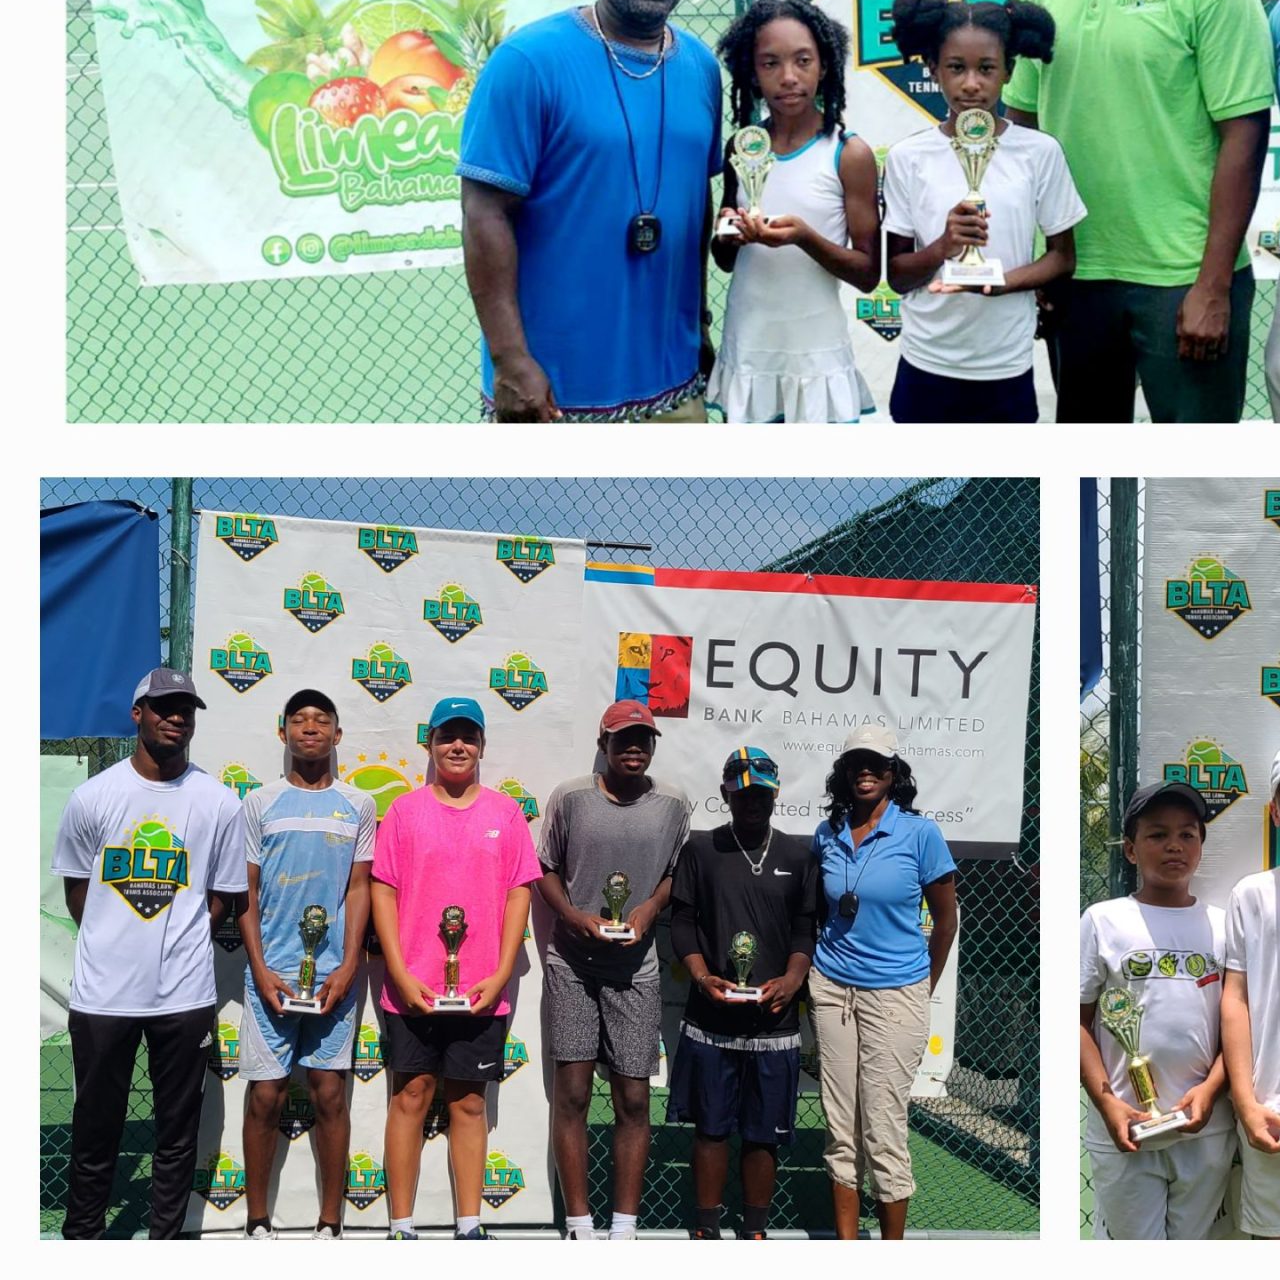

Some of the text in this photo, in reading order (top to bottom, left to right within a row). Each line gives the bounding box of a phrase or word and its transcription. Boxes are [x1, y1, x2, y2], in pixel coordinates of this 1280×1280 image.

[342, 171, 460, 207] Bahama
[216, 516, 279, 542] BLTA
[358, 528, 419, 553] BLTA
[496, 539, 555, 564] BLTA
[284, 588, 345, 614] BLTA
[1166, 580, 1252, 608] BLTA
[423, 599, 483, 624] BLTA
[210, 648, 272, 673] BLTA
[352, 658, 412, 683] BLTA
[706, 639, 988, 698] EQUITY
[489, 668, 549, 692] BLTA
[703, 707, 986, 732] BANK BAHAMAS LIMITED
[1164, 764, 1248, 793] BLTA
[102, 847, 188, 887] BLTA
